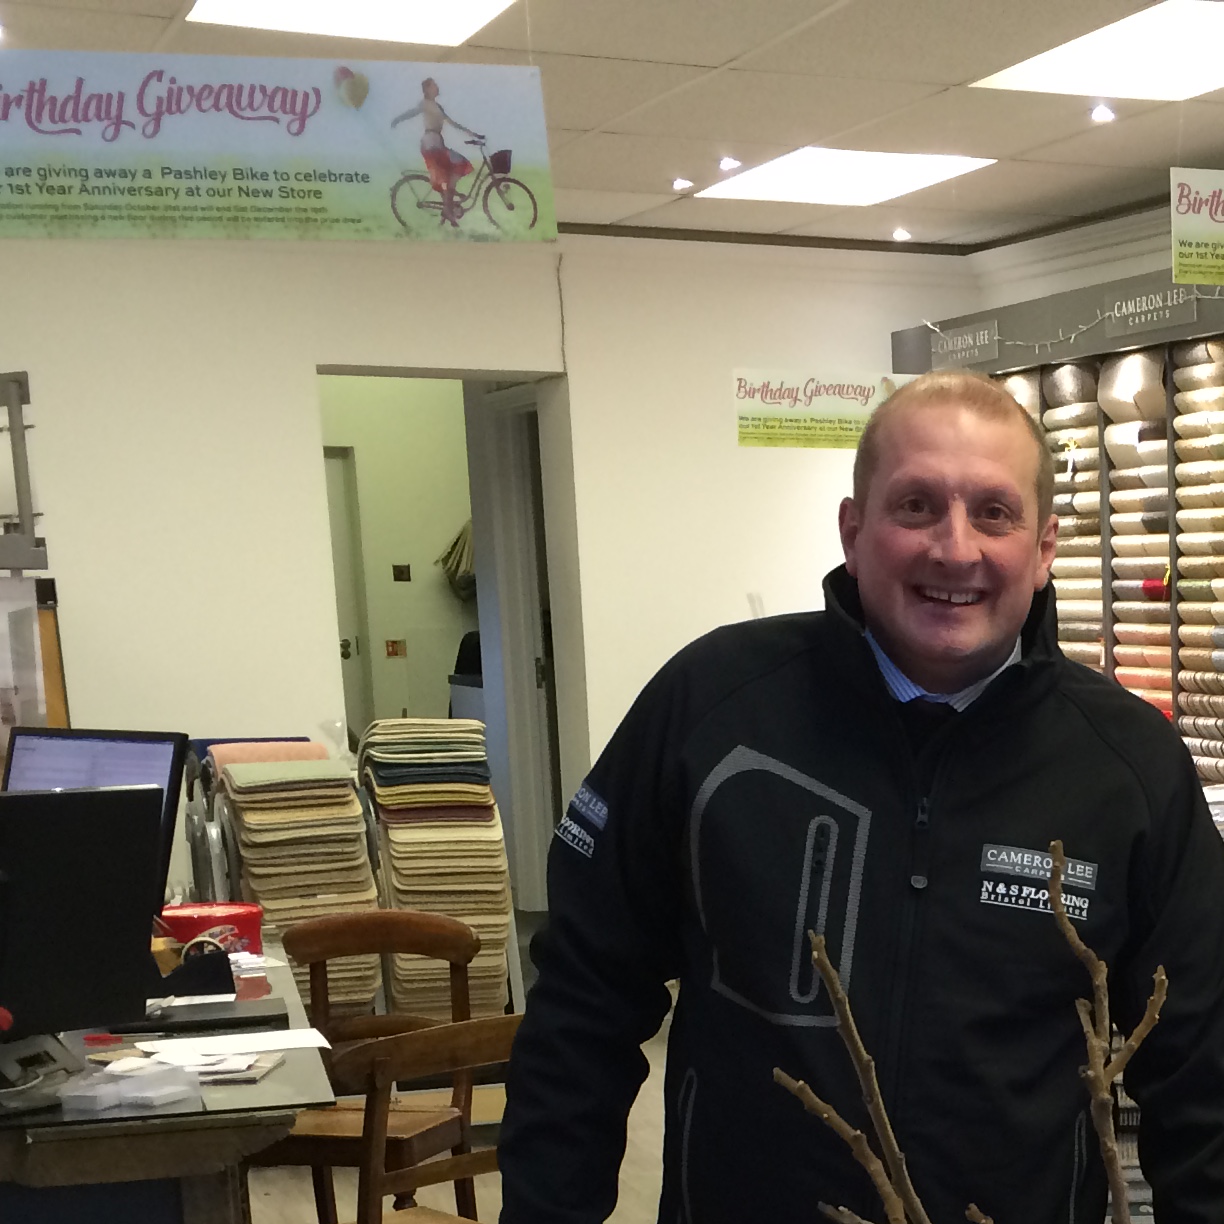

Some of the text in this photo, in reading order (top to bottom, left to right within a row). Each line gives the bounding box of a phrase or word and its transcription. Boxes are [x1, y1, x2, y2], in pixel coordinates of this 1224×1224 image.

[0, 70, 321, 142] rthday Giveaway
[5, 164, 370, 183] are giving away a Pashley Bike to celebrate
[7, 183, 32, 195] 1st
[36, 182, 74, 196] Year
[78, 182, 180, 200] Anniversary
[185, 185, 201, 197] at
[206, 187, 233, 198] our
[238, 186, 273, 198] New
[278, 186, 323, 199] Store
[1178, 239, 1193, 248] We
[1196, 251, 1208, 259] 1st
[1114, 288, 1186, 317] CAMERON LEE
[1129, 310, 1170, 326] CARPETS
[976, 330, 989, 345] LEE
[736, 378, 875, 408] Birthday Giveaway
[987, 849, 1093, 878] CAMERO LEE
[1015, 866, 1065, 880] CARPES
[980, 891, 1087, 917] Bristol Liited
[981, 880, 1089, 909] N & S FLORING
